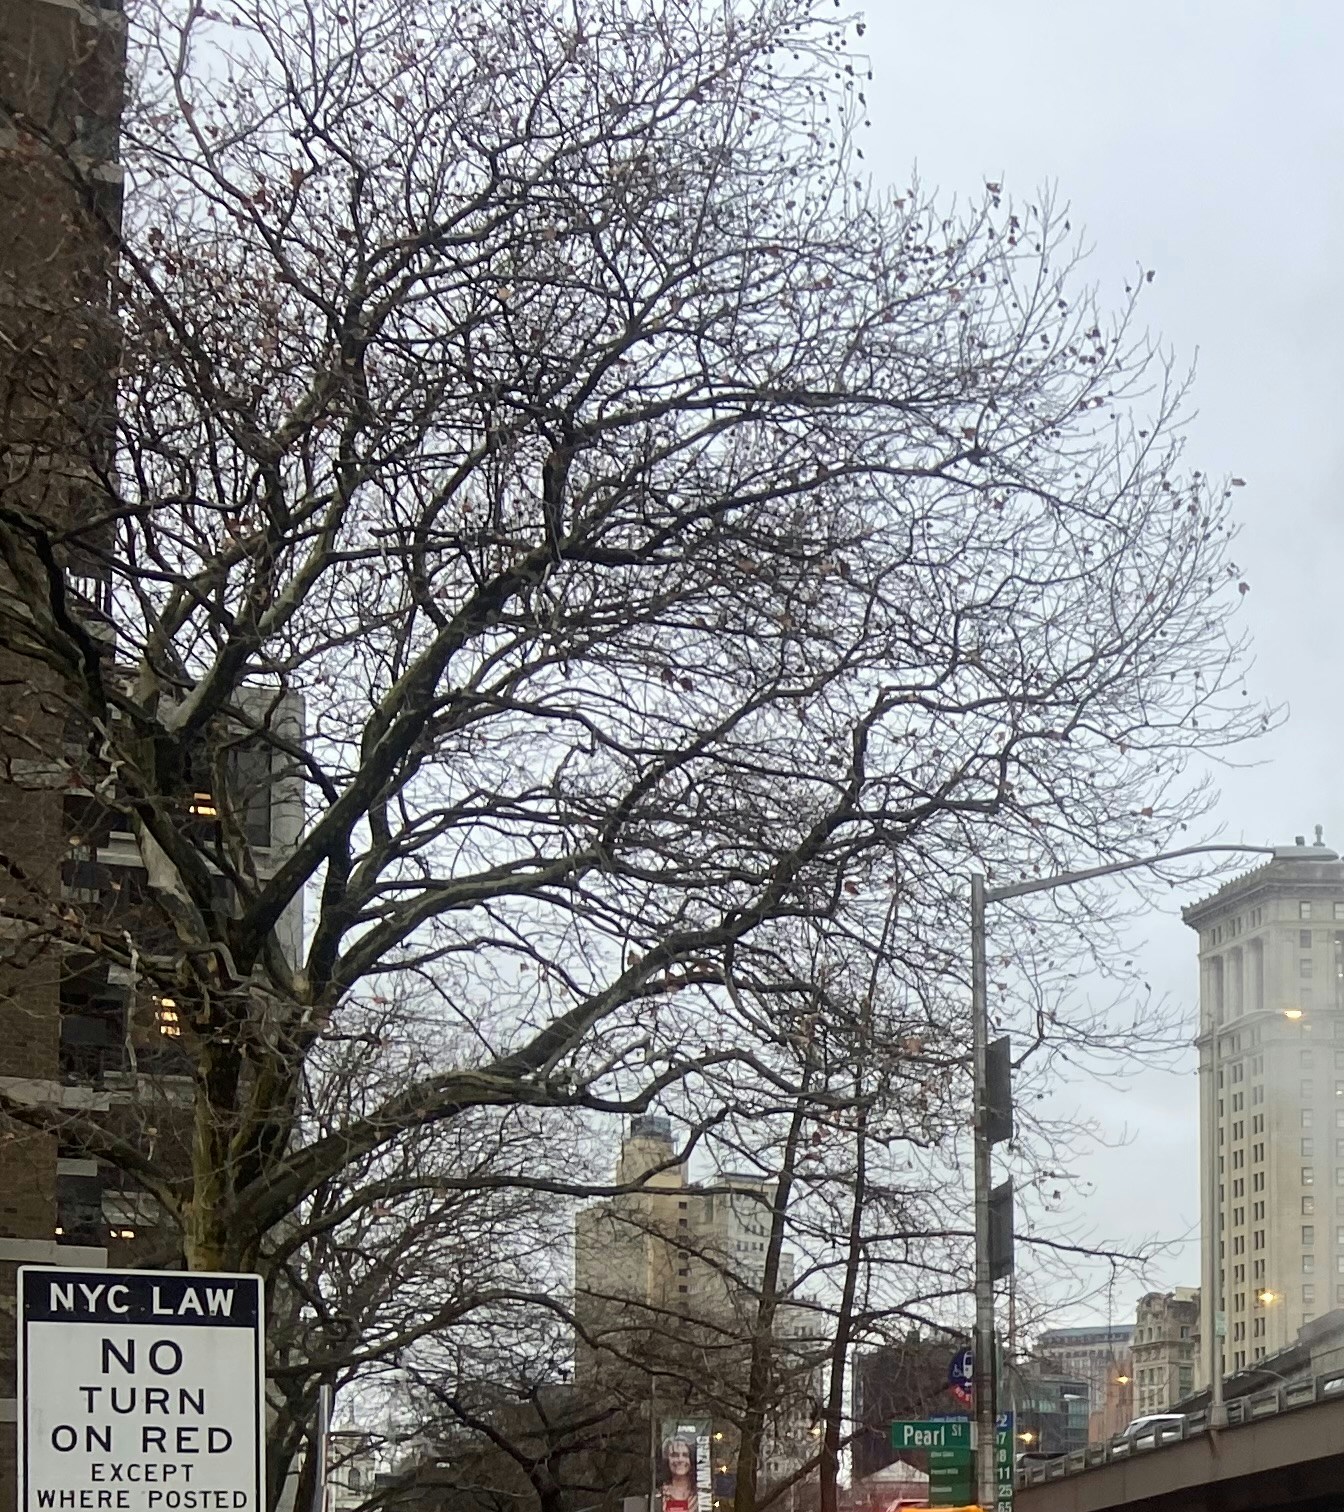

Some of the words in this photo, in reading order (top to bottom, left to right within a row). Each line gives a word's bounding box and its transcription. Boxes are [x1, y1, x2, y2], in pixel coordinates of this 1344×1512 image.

[50, 1283, 130, 1313] NYC
[153, 1287, 235, 1317] LAW
[101, 1338, 183, 1375] NO
[79, 1387, 204, 1415] TURN
[51, 1425, 112, 1452] ON
[142, 1426, 233, 1453] RED
[903, 1425, 946, 1446] Pearl
[951, 1422, 962, 1436] St
[91, 1463, 194, 1482] EXCEPT
[37, 1489, 130, 1508] WHERE
[148, 1490, 247, 1508] POSTED
